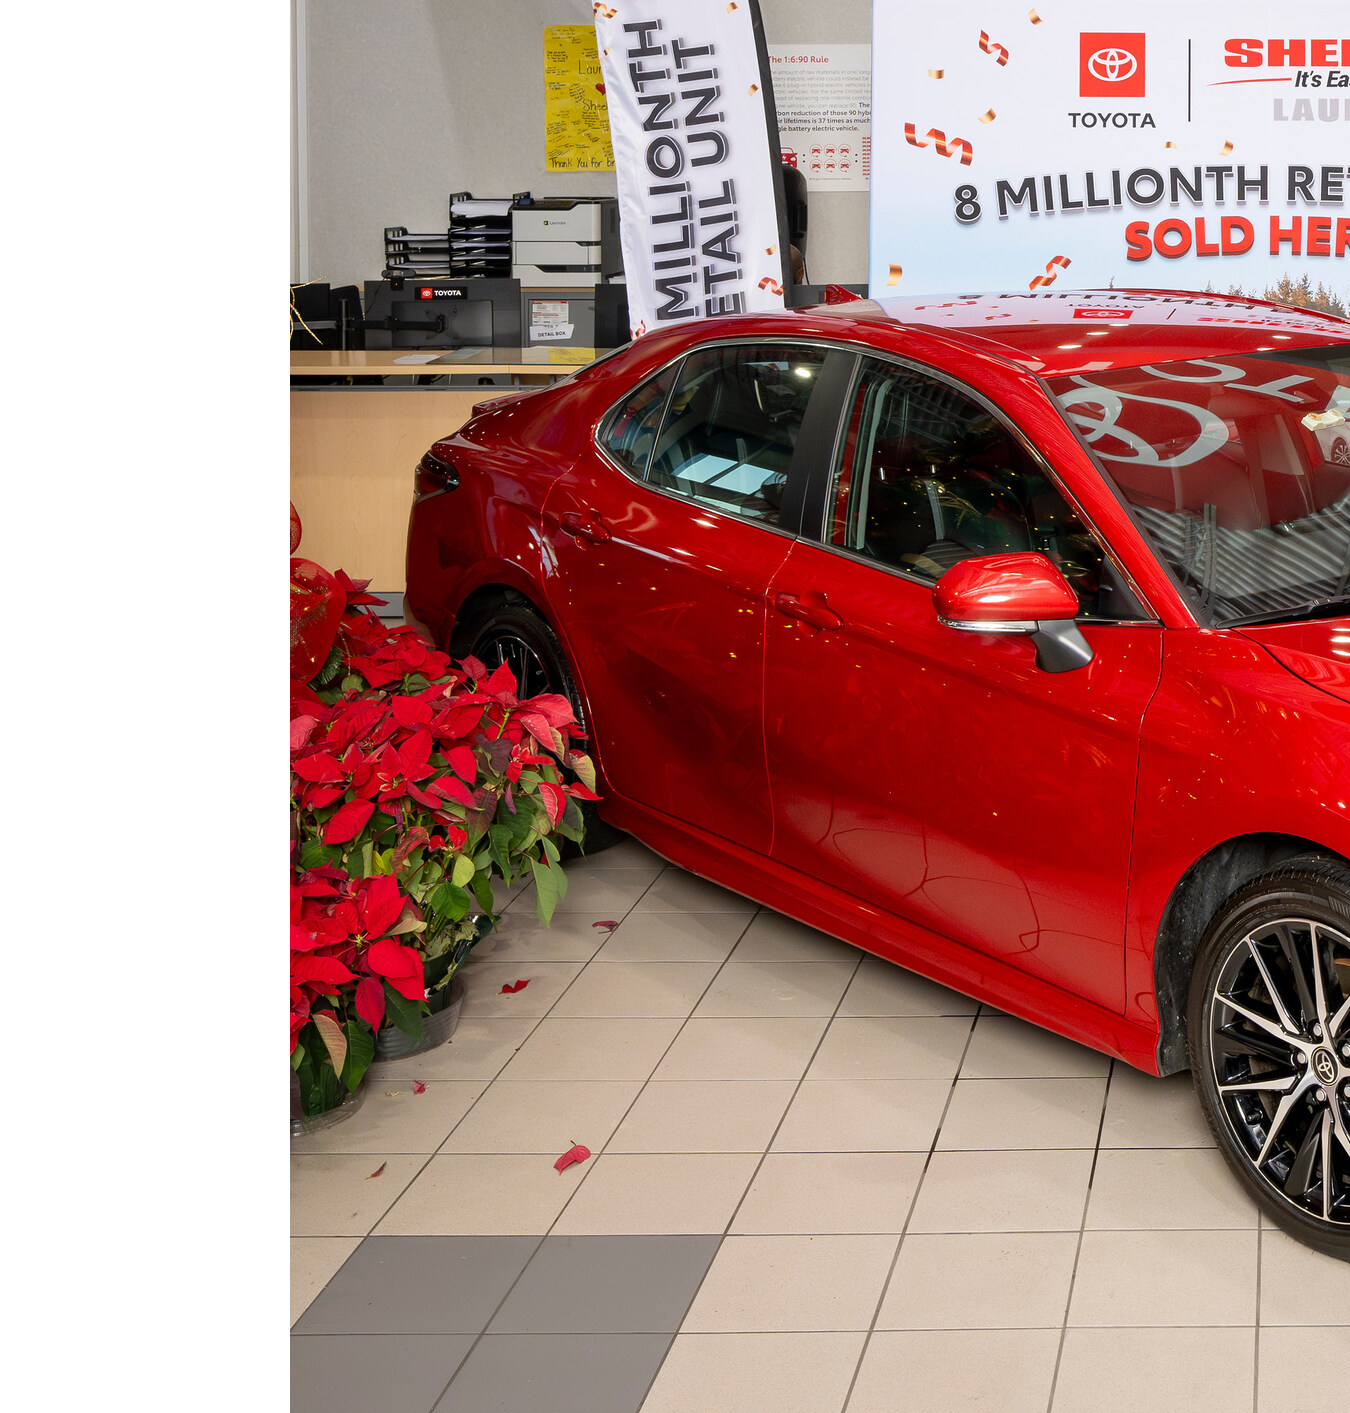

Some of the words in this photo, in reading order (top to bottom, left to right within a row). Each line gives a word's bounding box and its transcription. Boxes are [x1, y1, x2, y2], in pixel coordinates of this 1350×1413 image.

[579, 59, 601, 75] Laur
[1295, 71, 1325, 88] It's
[582, 98, 607, 112] Shee
[671, 36, 730, 169] UNIT
[1068, 112, 1156, 128] TOYOTA
[549, 157, 572, 168] Thank
[577, 157, 588, 168] You
[591, 157, 603, 168] for
[622, 18, 699, 321] MILLIONTH
[953, 183, 983, 224] 8
[996, 164, 1270, 219] MILLIONTH
[698, 178, 746, 317] ETAIL
[1125, 215, 1255, 262] SOLD
